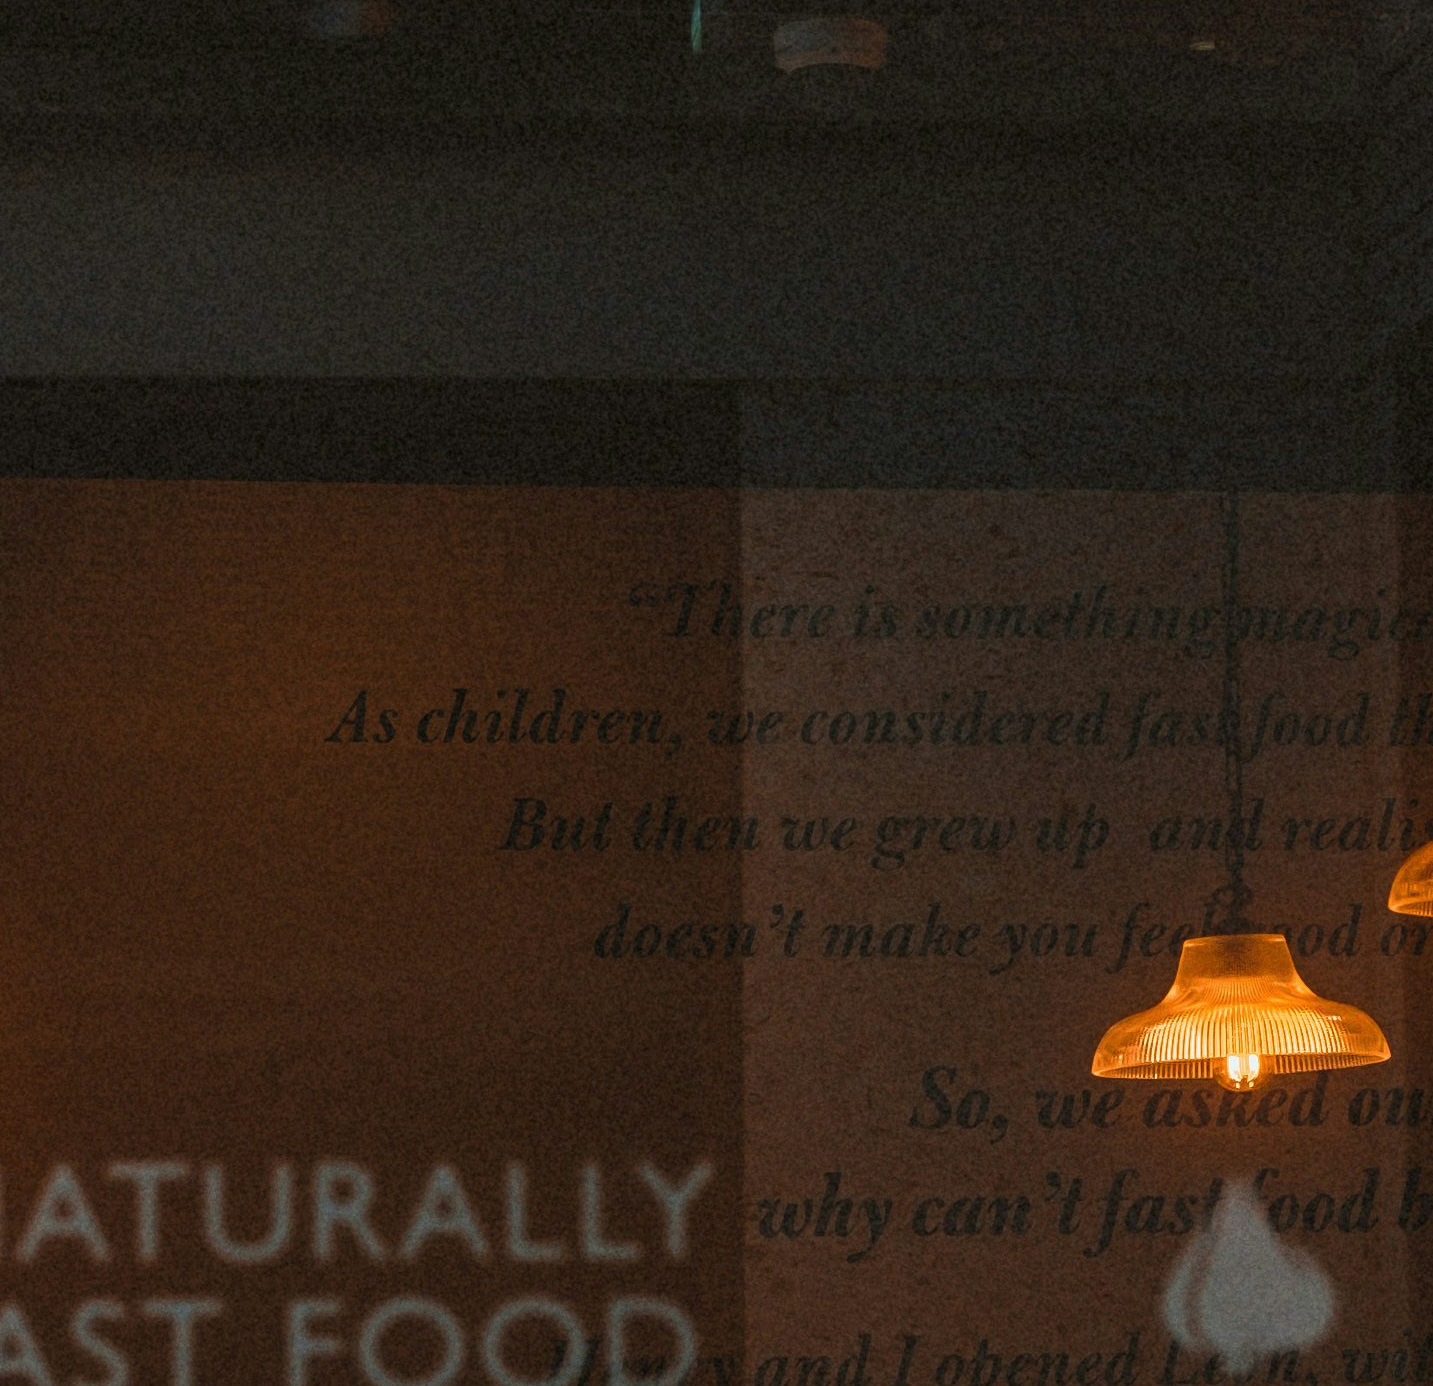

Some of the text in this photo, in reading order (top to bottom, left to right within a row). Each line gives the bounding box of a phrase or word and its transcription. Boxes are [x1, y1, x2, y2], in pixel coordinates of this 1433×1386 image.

[855, 585, 901, 640] is
[914, 585, 1218, 659] something
[323, 688, 400, 745] As
[414, 686, 685, 756] children,
[705, 707, 788, 747] we
[798, 690, 1110, 747] considered
[1234, 688, 1371, 763] food
[496, 797, 614, 855] But
[631, 795, 763, 856] then
[779, 816, 858, 853] we
[872, 813, 1016, 869] grew
[1033, 808, 1110, 870] up
[1150, 796, 1268, 853] and
[823, 902, 982, 961] make
[988, 919, 1097, 976] you
[908, 1066, 1008, 1144] So,
[1034, 1087, 1121, 1127] we
[1143, 1075, 1322, 1128] asked
[756, 1171, 894, 1264] why
